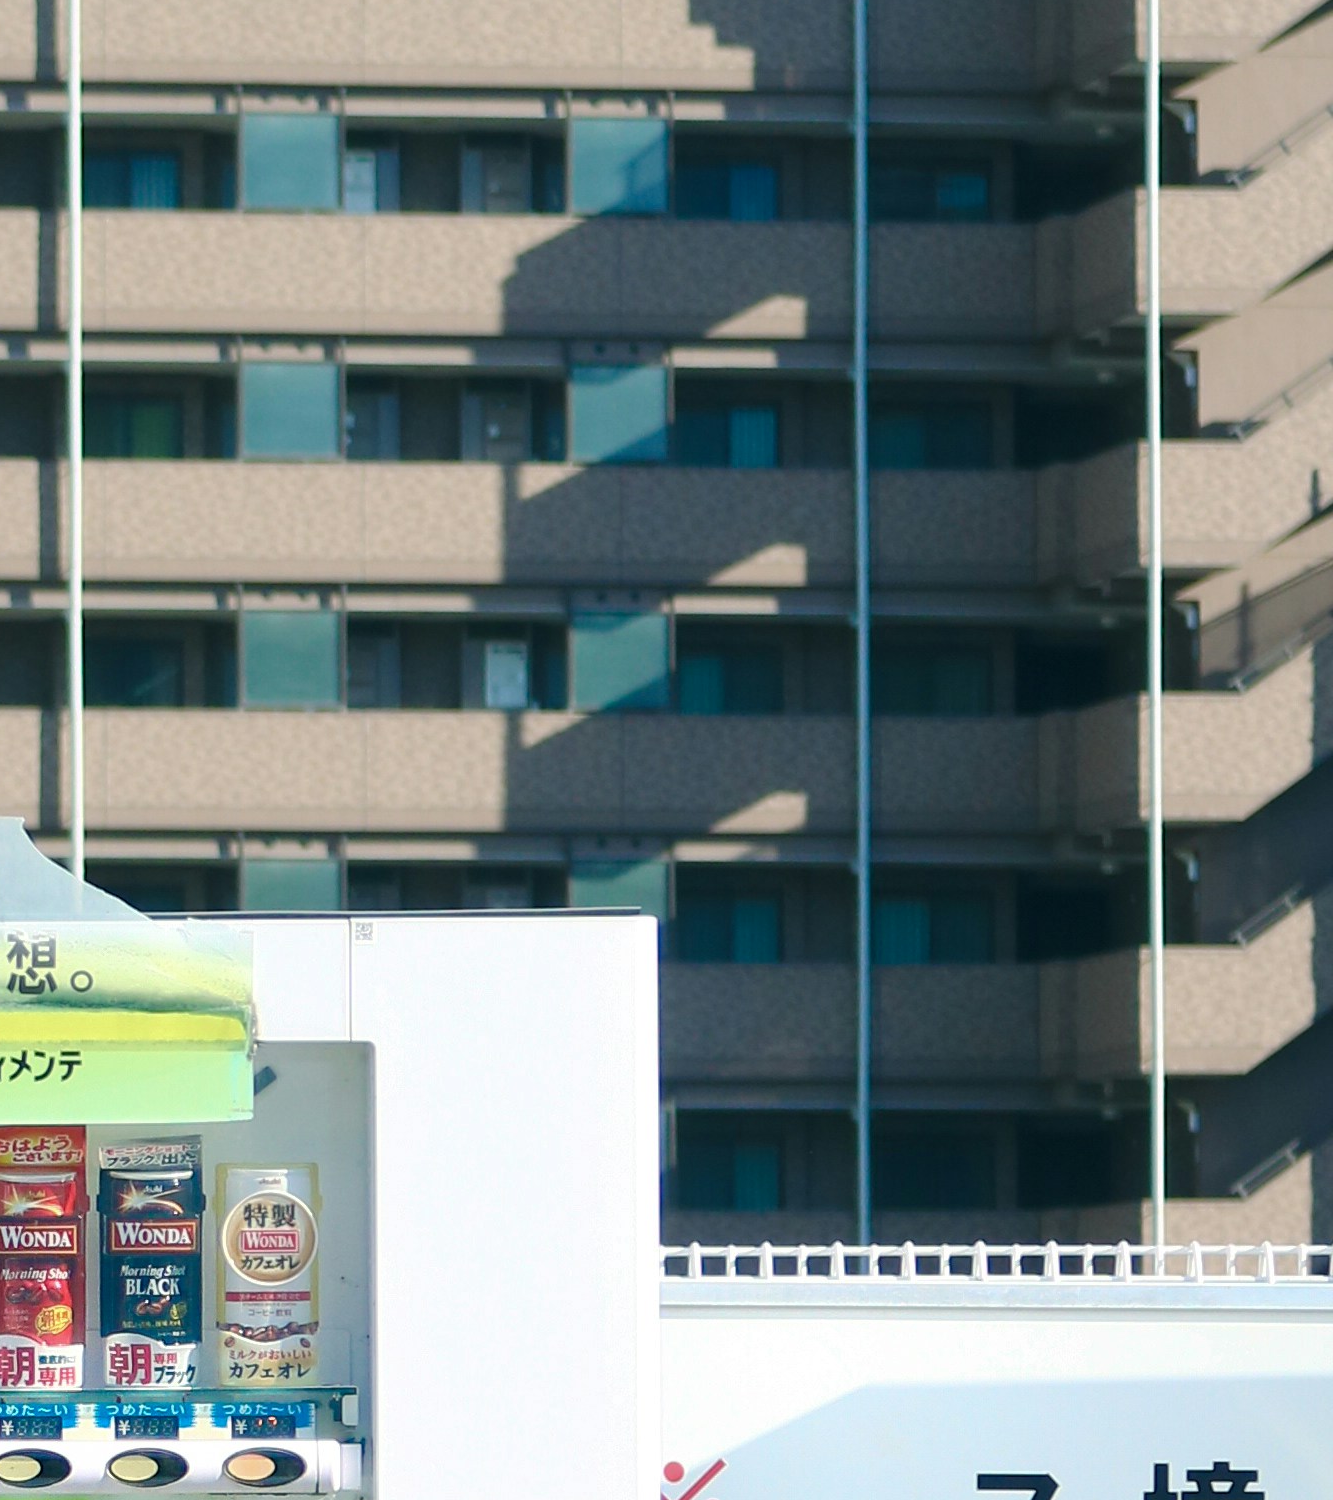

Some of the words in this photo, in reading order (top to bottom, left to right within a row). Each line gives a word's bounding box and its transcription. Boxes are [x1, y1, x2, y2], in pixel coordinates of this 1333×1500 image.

[243, 1204, 296, 1229] 特製
[0, 1225, 73, 1249] WONDA
[116, 1221, 192, 1246] WONDA
[245, 1232, 295, 1249] WONDA
[241, 1256, 300, 1271] カフェオレ
[0, 1267, 47, 1282] Morning
[125, 1278, 180, 1296] BLACK
[109, 1343, 152, 1386] 朝
[229, 1363, 311, 1379] カフェオレ
[37, 1366, 77, 1387] 専用
